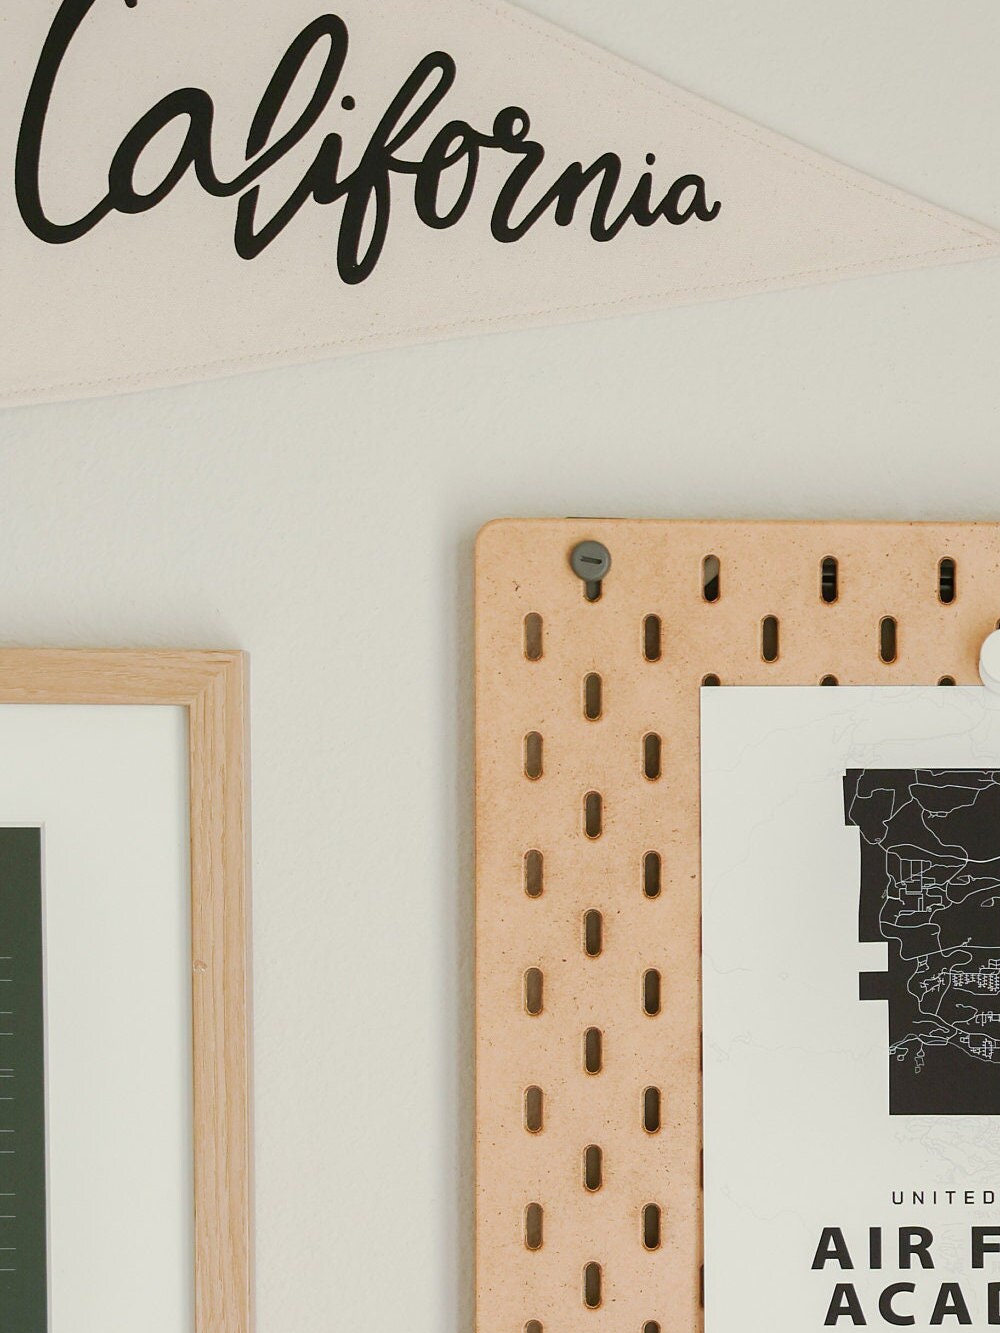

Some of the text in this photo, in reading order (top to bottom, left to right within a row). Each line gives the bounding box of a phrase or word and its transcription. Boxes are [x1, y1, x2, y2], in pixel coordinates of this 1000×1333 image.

[15, 0, 722, 285] California
[892, 1190, 995, 1205] UNITED
[811, 1226, 935, 1270] AIR
